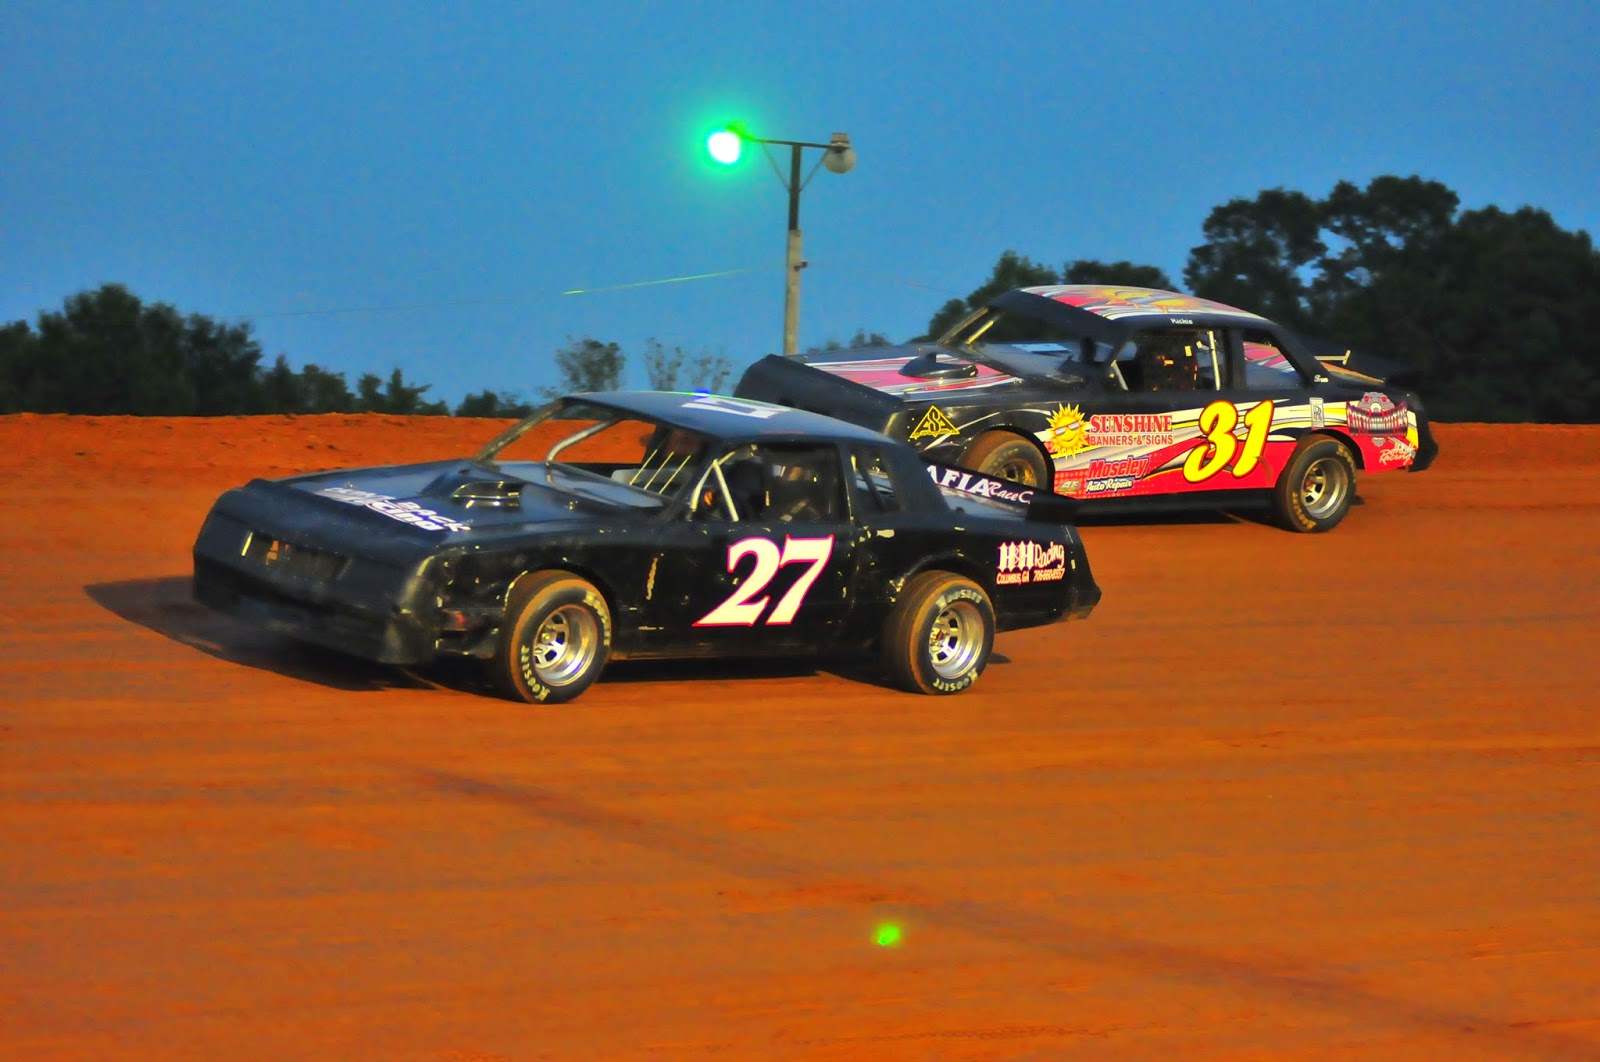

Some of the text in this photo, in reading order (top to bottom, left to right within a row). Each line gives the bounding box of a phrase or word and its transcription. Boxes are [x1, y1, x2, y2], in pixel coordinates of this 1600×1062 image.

[1090, 415, 1173, 434] SUNSHINE
[1090, 434, 1173, 446] BANNERS & SIGNS
[1183, 400, 1275, 484] 31
[1086, 456, 1149, 481] Moseley
[988, 481, 1020, 502] Race
[1086, 478, 1133, 494] Auto Repair
[1034, 541, 1065, 569] Racing
[692, 534, 835, 627] 27
